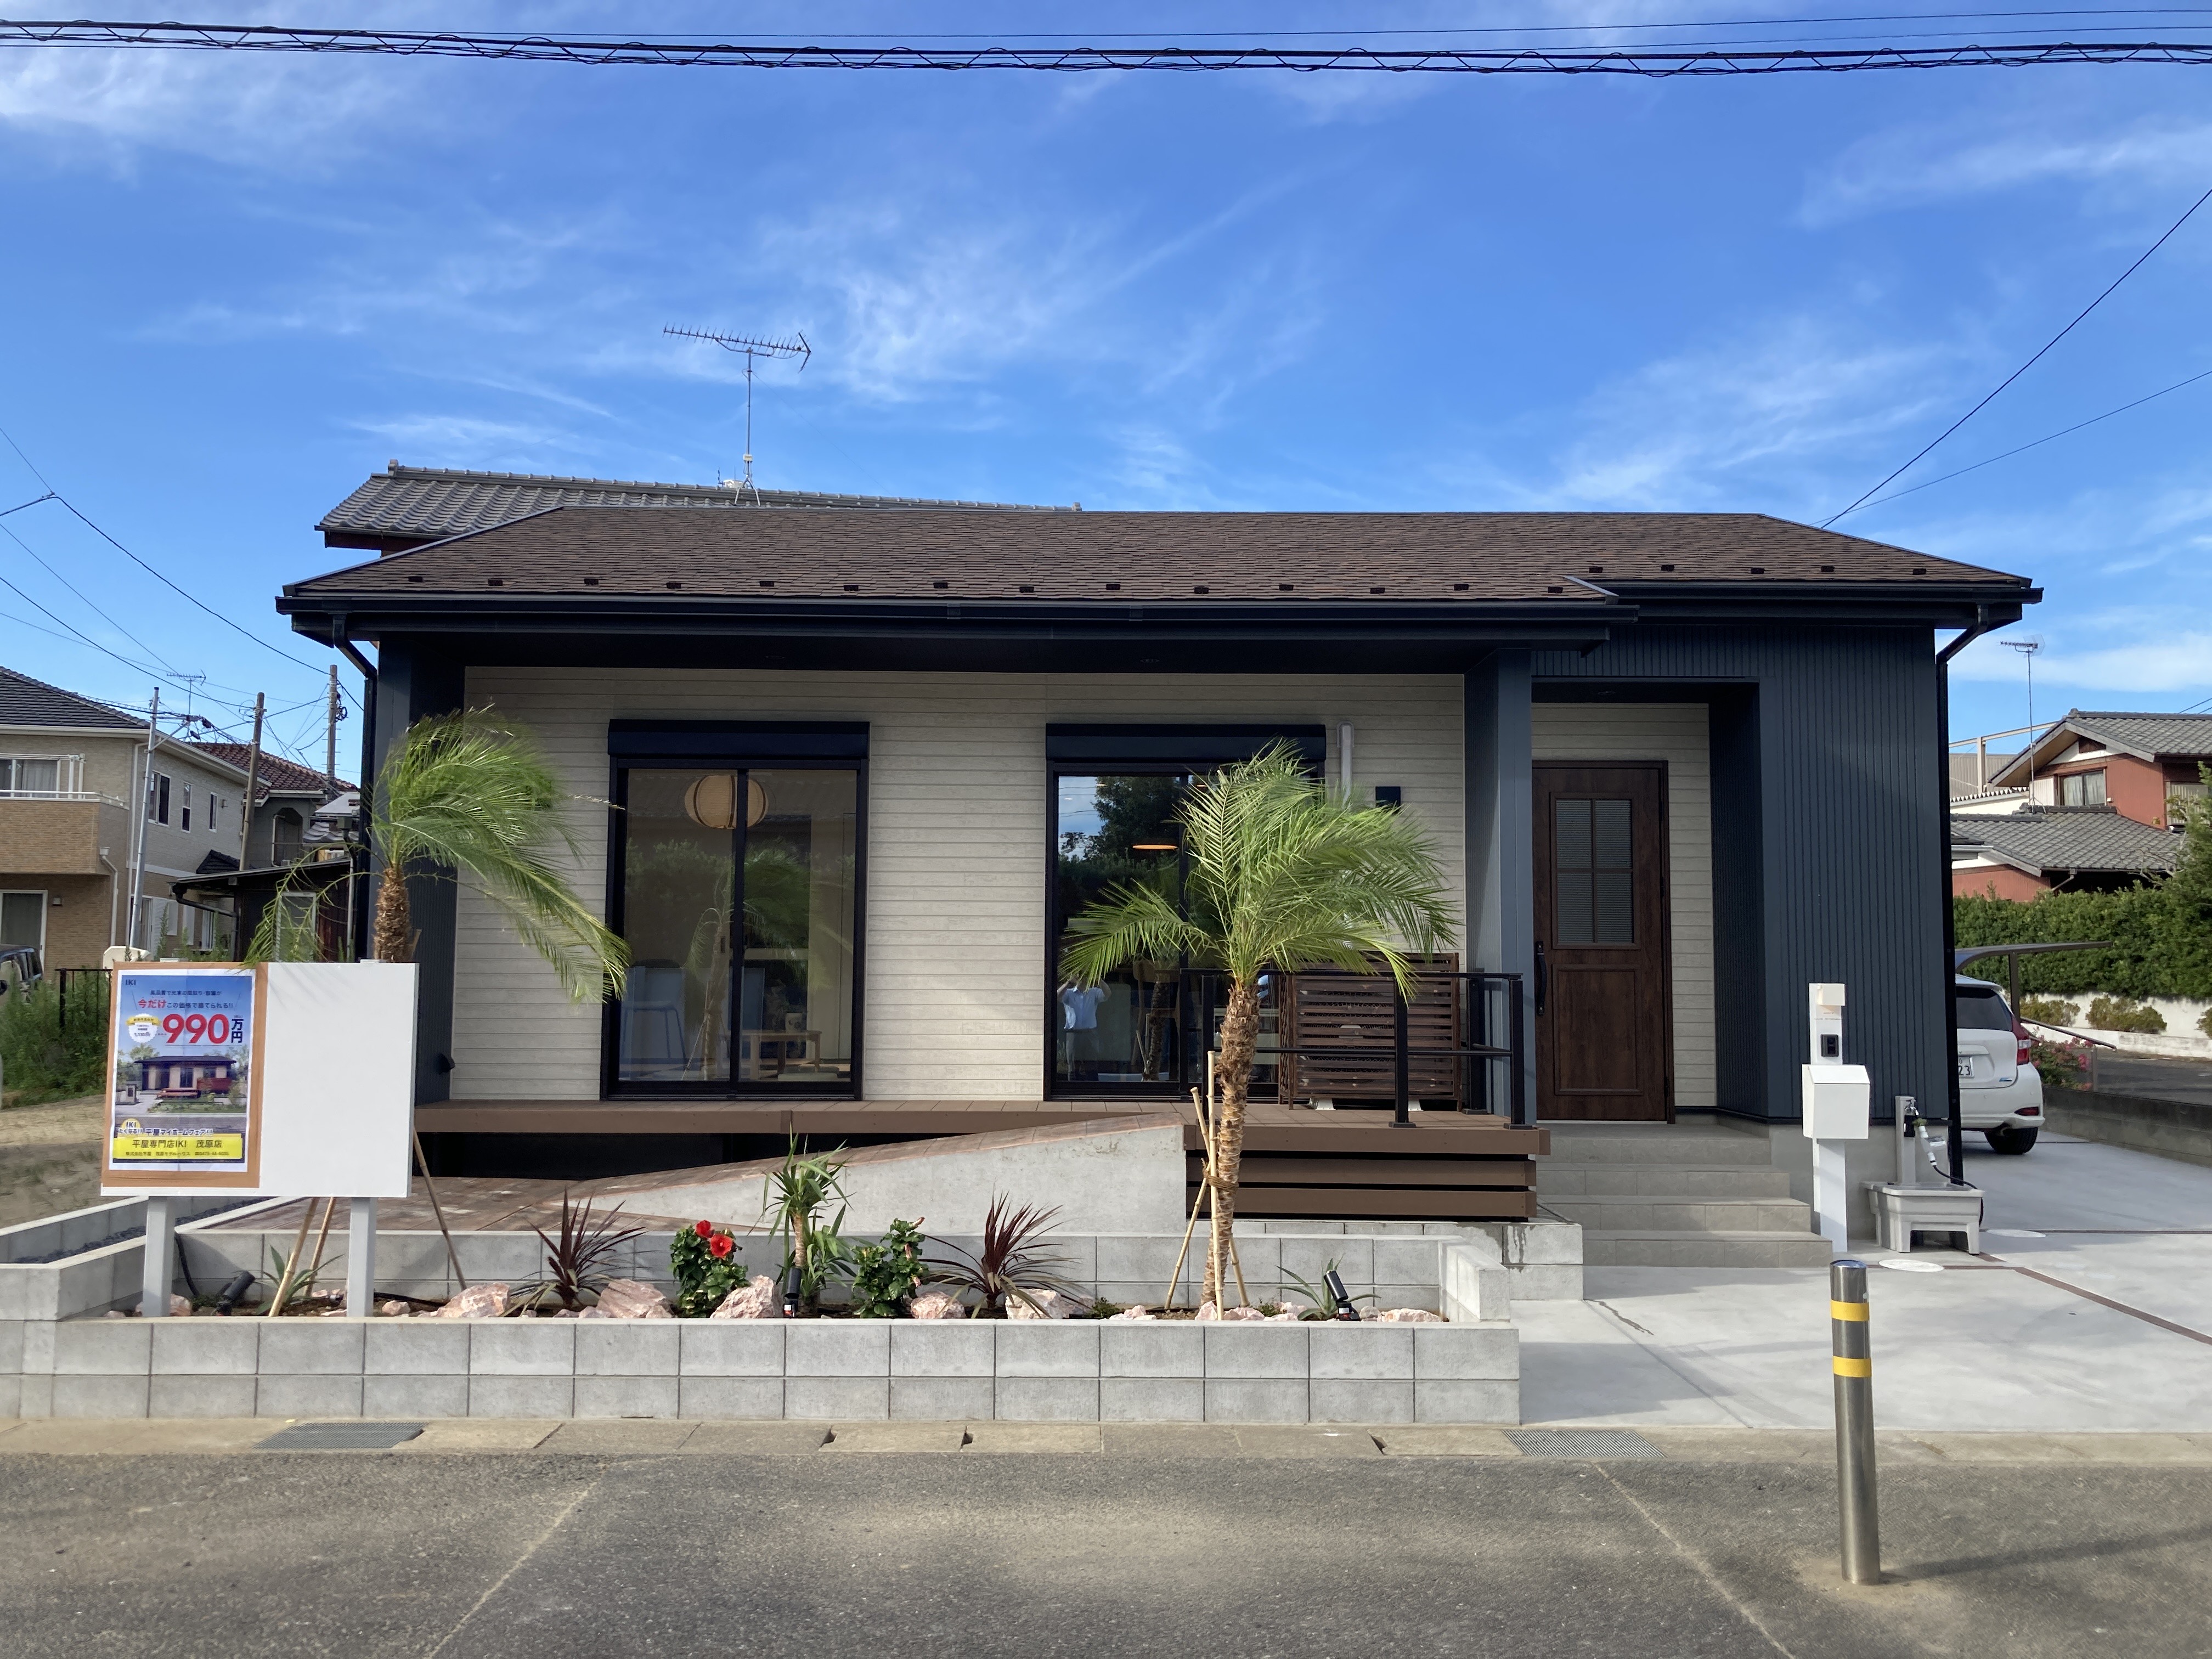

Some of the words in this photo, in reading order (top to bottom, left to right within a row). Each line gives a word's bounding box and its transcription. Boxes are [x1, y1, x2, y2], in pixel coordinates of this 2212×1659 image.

[163, 1013, 229, 1044] 990
[231, 1018, 244, 1043] 万円
[1958, 1065, 1971, 1075] 23
[132, 1139, 187, 1148] 平屋専門店IKI
[196, 1139, 222, 1148] 茂原店
